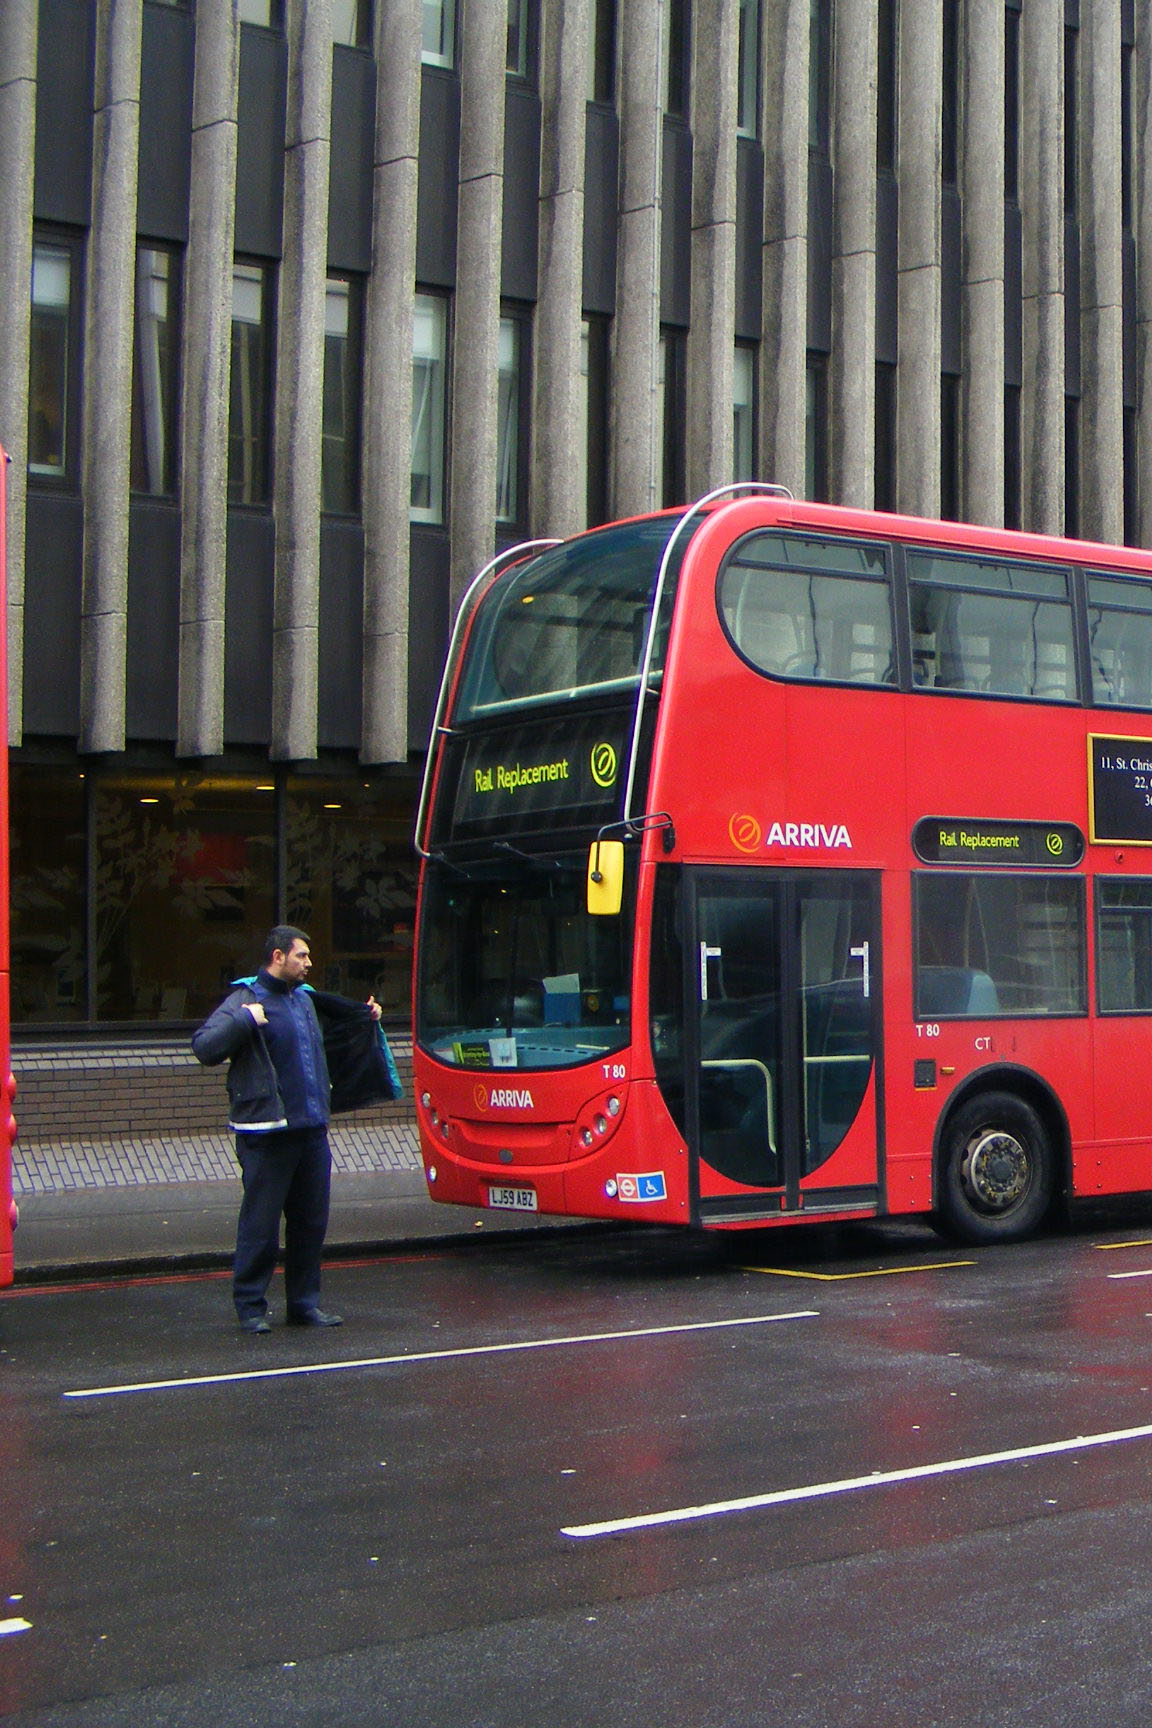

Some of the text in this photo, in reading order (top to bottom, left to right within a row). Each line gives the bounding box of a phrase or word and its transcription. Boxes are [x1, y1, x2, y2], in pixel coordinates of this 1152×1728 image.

[1116, 758, 1128, 770] St.
[474, 758, 569, 795] Rail Replacement
[1135, 777, 1149, 790] 22,
[767, 822, 852, 848] ARRIVA
[939, 831, 1020, 850] Rail Replacement
[916, 1023, 940, 1037] T 80
[975, 1037, 991, 1050] CT
[603, 1064, 626, 1078] T 80
[490, 1089, 534, 1109] ARRIVA
[491, 1189, 534, 1207] LJ59 ABZ
